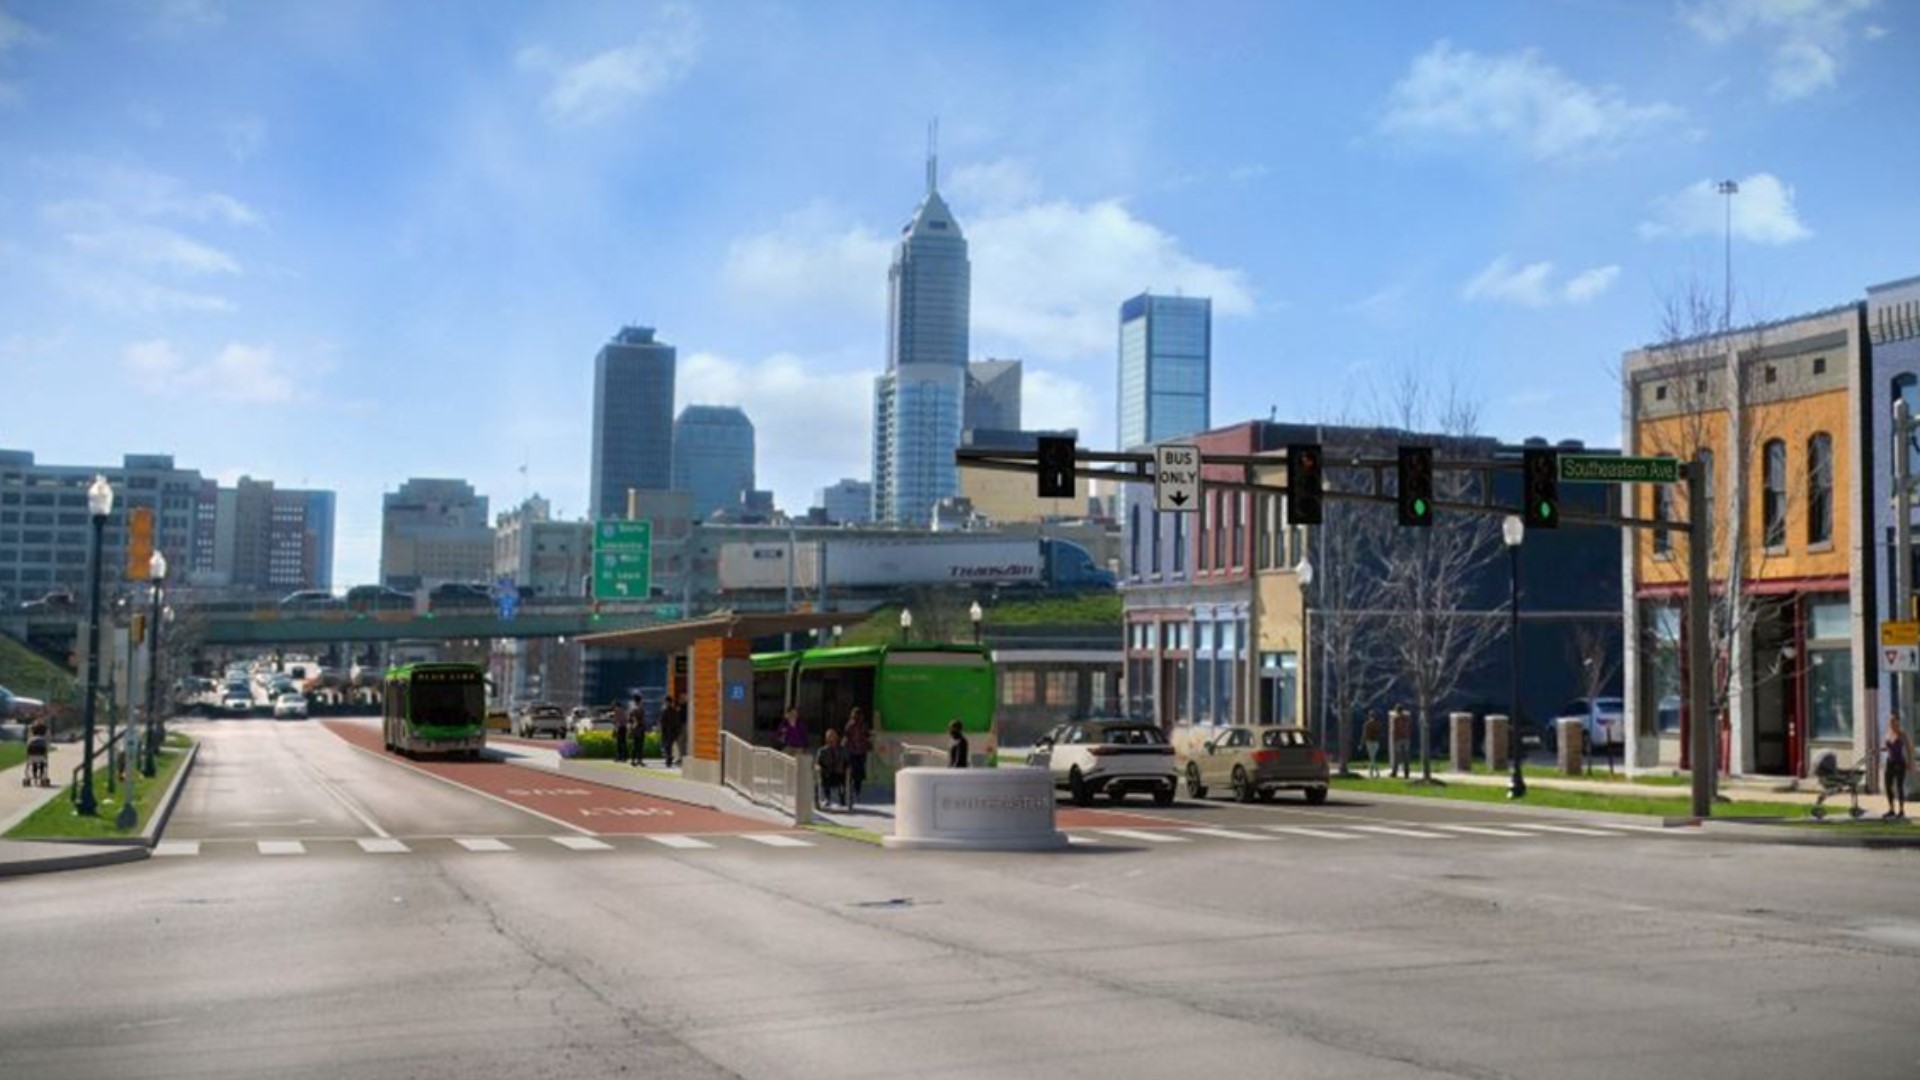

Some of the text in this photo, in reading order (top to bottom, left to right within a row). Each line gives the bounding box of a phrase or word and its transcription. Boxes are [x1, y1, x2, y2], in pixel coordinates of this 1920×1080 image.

[1166, 451, 1193, 465] BUS
[1564, 459, 1673, 478] Southeastern Ave
[1160, 471, 1197, 484] ONLY
